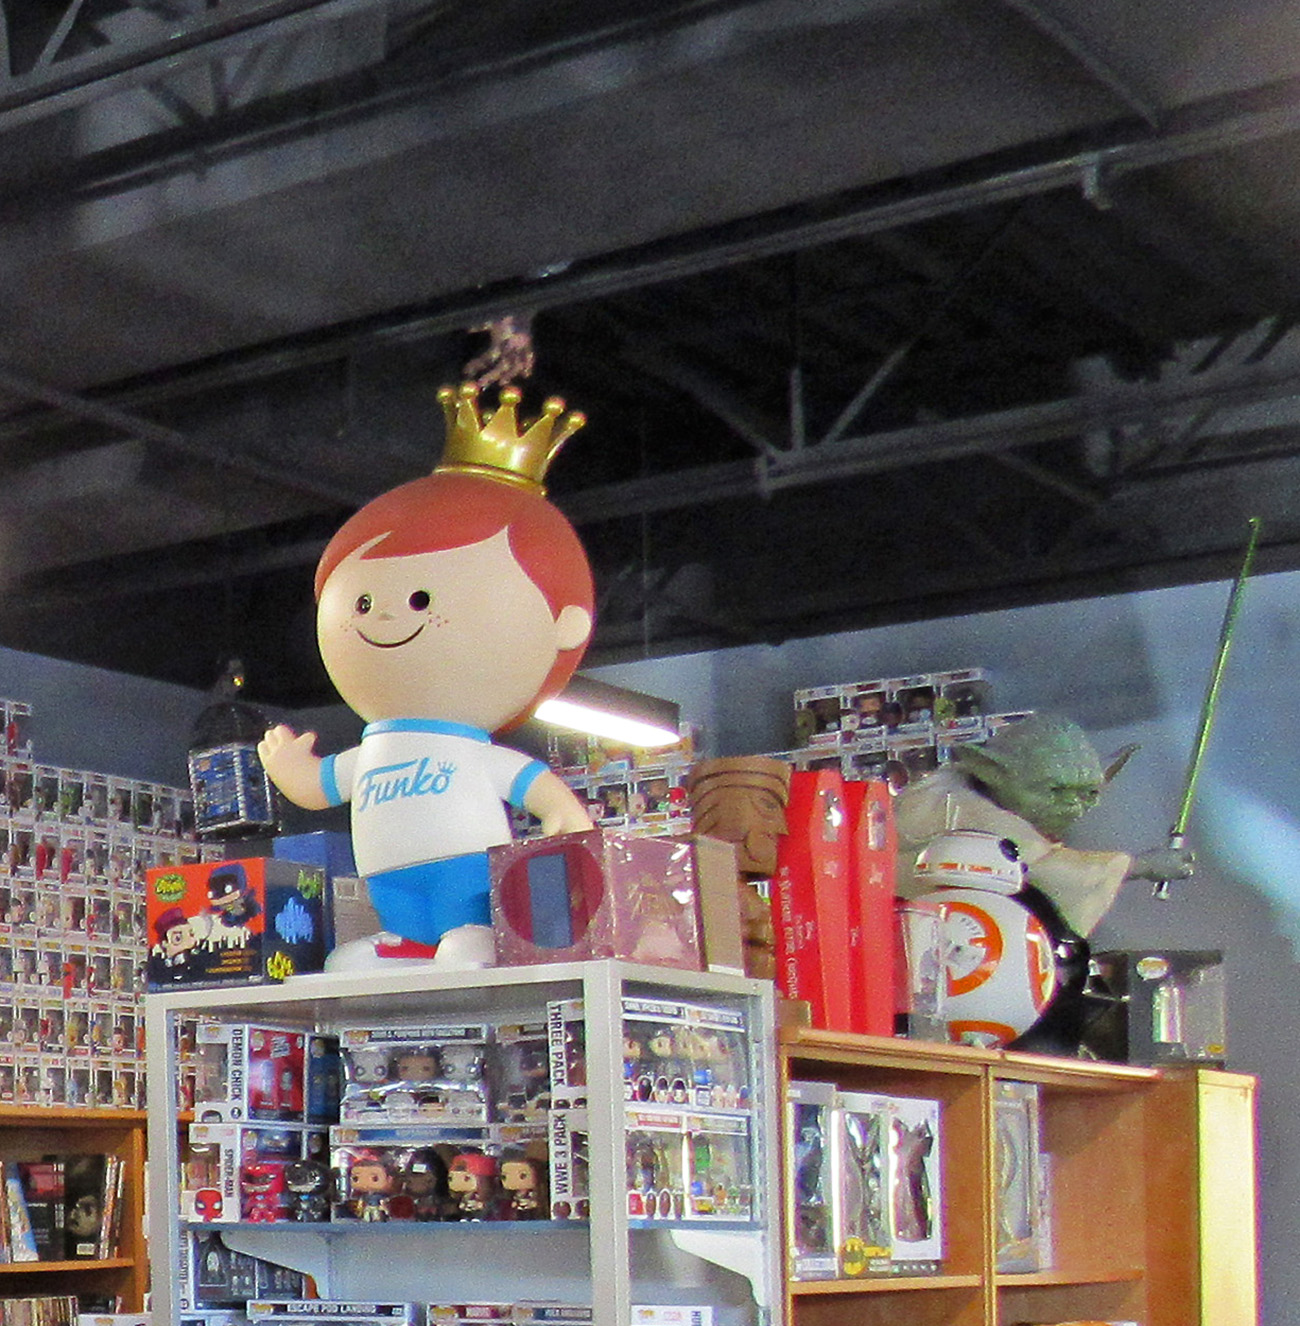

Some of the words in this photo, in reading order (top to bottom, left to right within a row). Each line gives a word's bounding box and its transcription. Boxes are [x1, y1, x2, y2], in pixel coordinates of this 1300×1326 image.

[359, 758, 453, 812] Funko
[550, 1005, 564, 1046] THREE
[232, 1029, 243, 1068] DEMON
[232, 1071, 243, 1100] CHICK
[551, 1052, 565, 1086] PACK
[553, 1114, 567, 1146] PACK
[553, 1150, 567, 1158] 3
[554, 1163, 568, 1194] WWE
